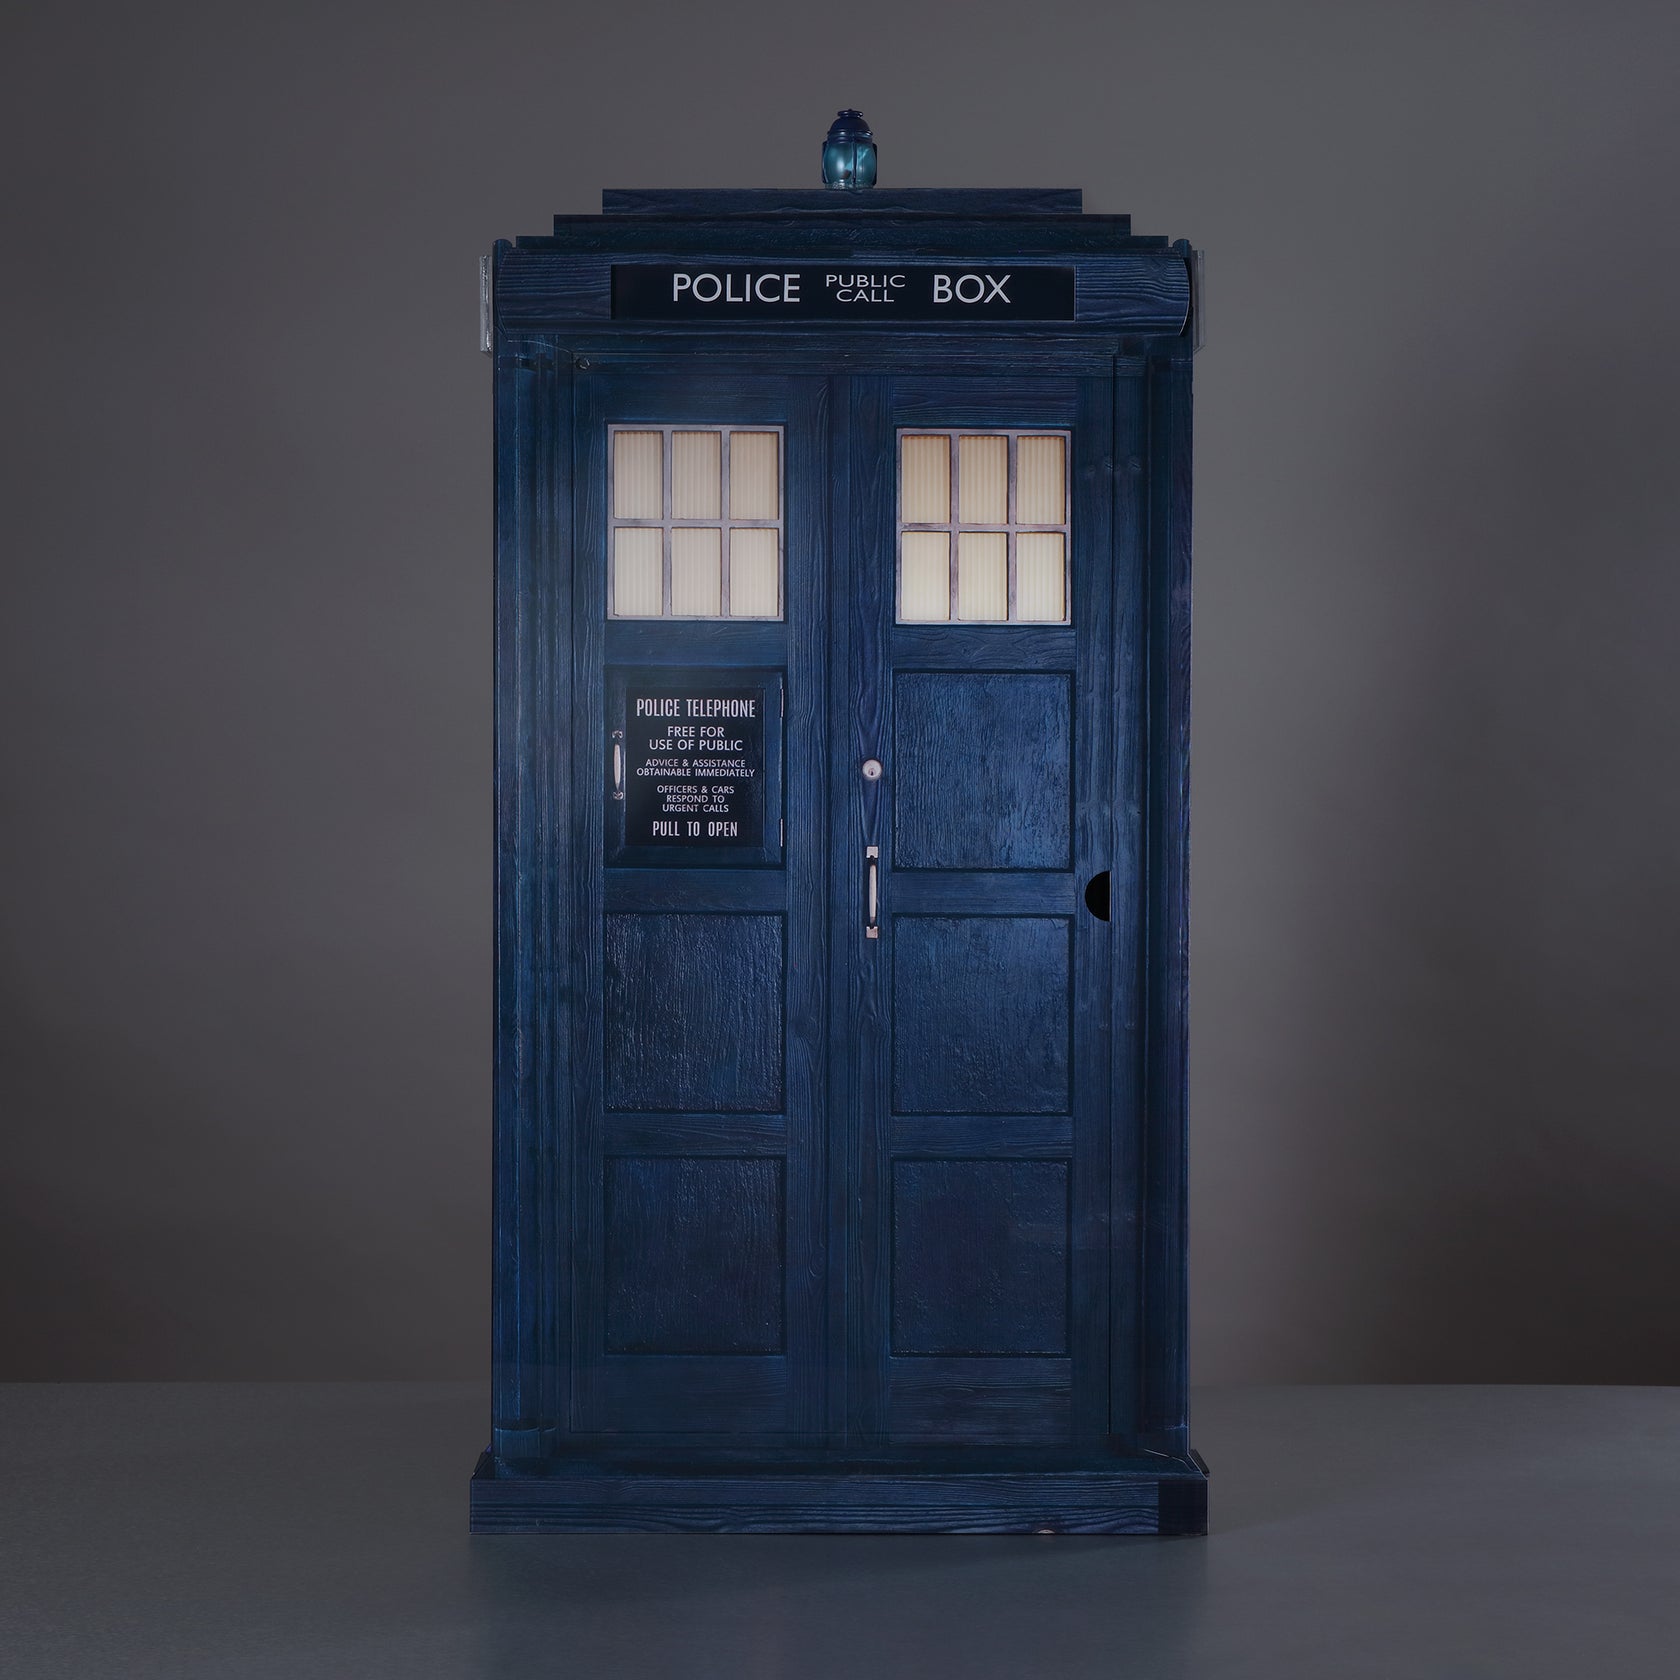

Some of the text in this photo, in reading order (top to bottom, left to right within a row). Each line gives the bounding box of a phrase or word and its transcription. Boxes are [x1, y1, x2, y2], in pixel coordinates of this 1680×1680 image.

[825, 274, 906, 288] PUBLIC
[673, 273, 801, 304] POLICE
[835, 288, 895, 303] CALL
[933, 274, 1011, 304] BOX
[636, 698, 756, 718] POLICE TELEPHONE
[667, 725, 725, 738] FREE FOR
[648, 738, 744, 752] USE OF PUBLIC
[645, 758, 746, 769] ADVICE & ASSISTANCE
[636, 767, 756, 778] OBTAINABLE IMMEDIATELY
[656, 784, 735, 794] OFFICERS & CARS
[666, 794, 725, 804] RESPOND TO
[662, 803, 729, 813] URGENT CALLS
[652, 820, 738, 837] PULL TO OPEN
